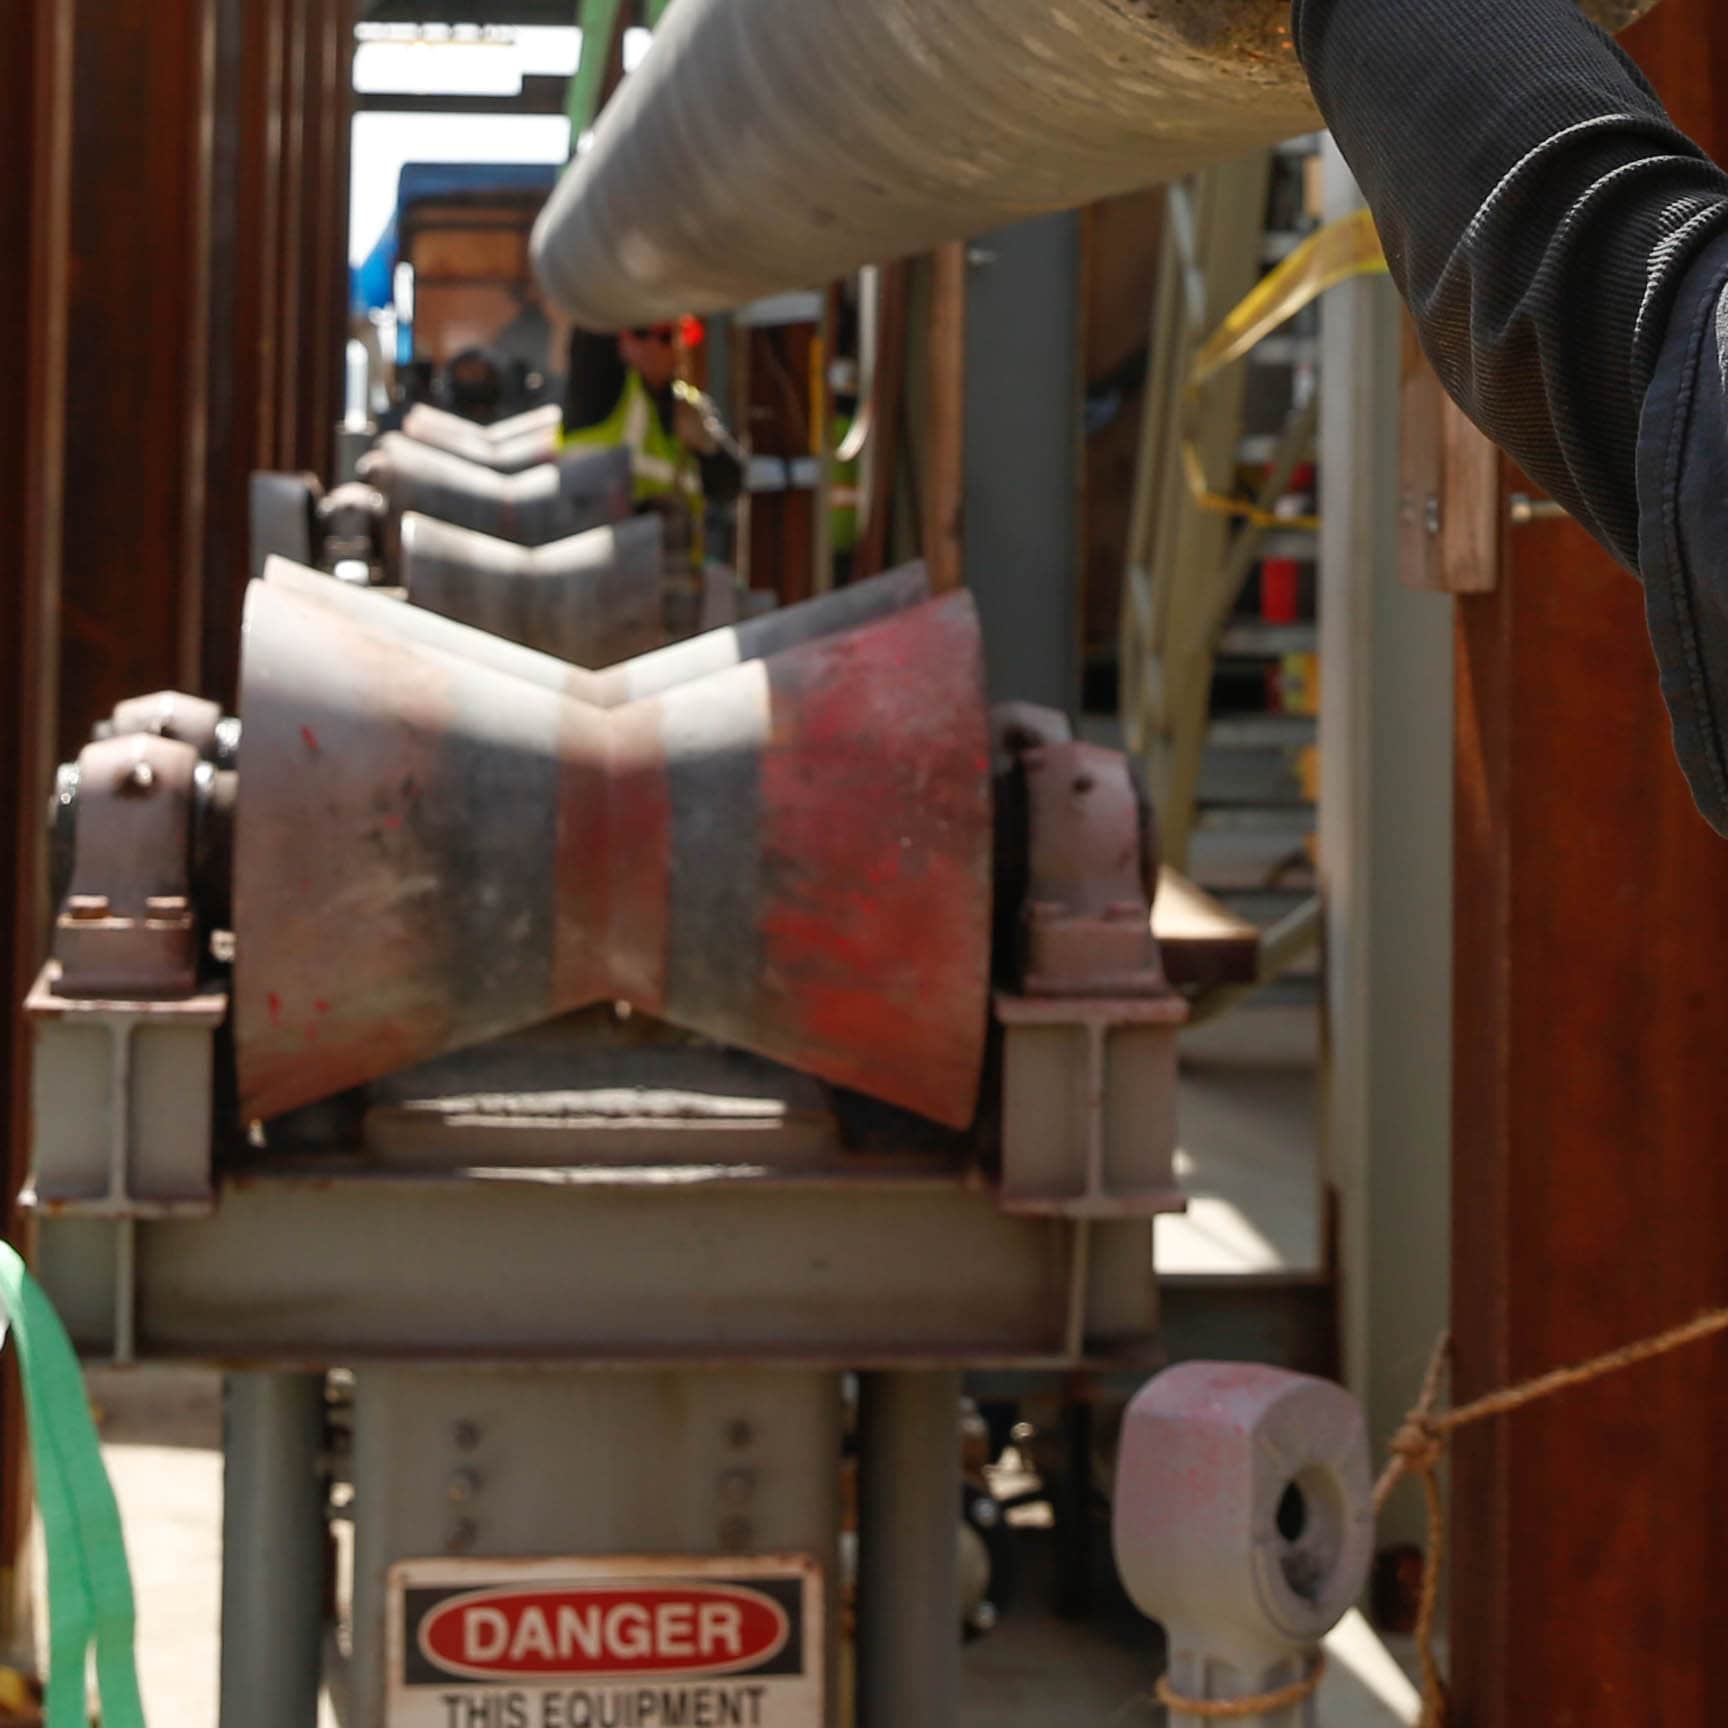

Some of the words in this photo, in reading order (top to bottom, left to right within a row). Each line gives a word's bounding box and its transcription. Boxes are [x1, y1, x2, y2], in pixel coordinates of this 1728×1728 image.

[462, 1601, 742, 1662] DANGER
[440, 1691, 528, 1728] THIS
[542, 1686, 768, 1728] EQUIPMENT
